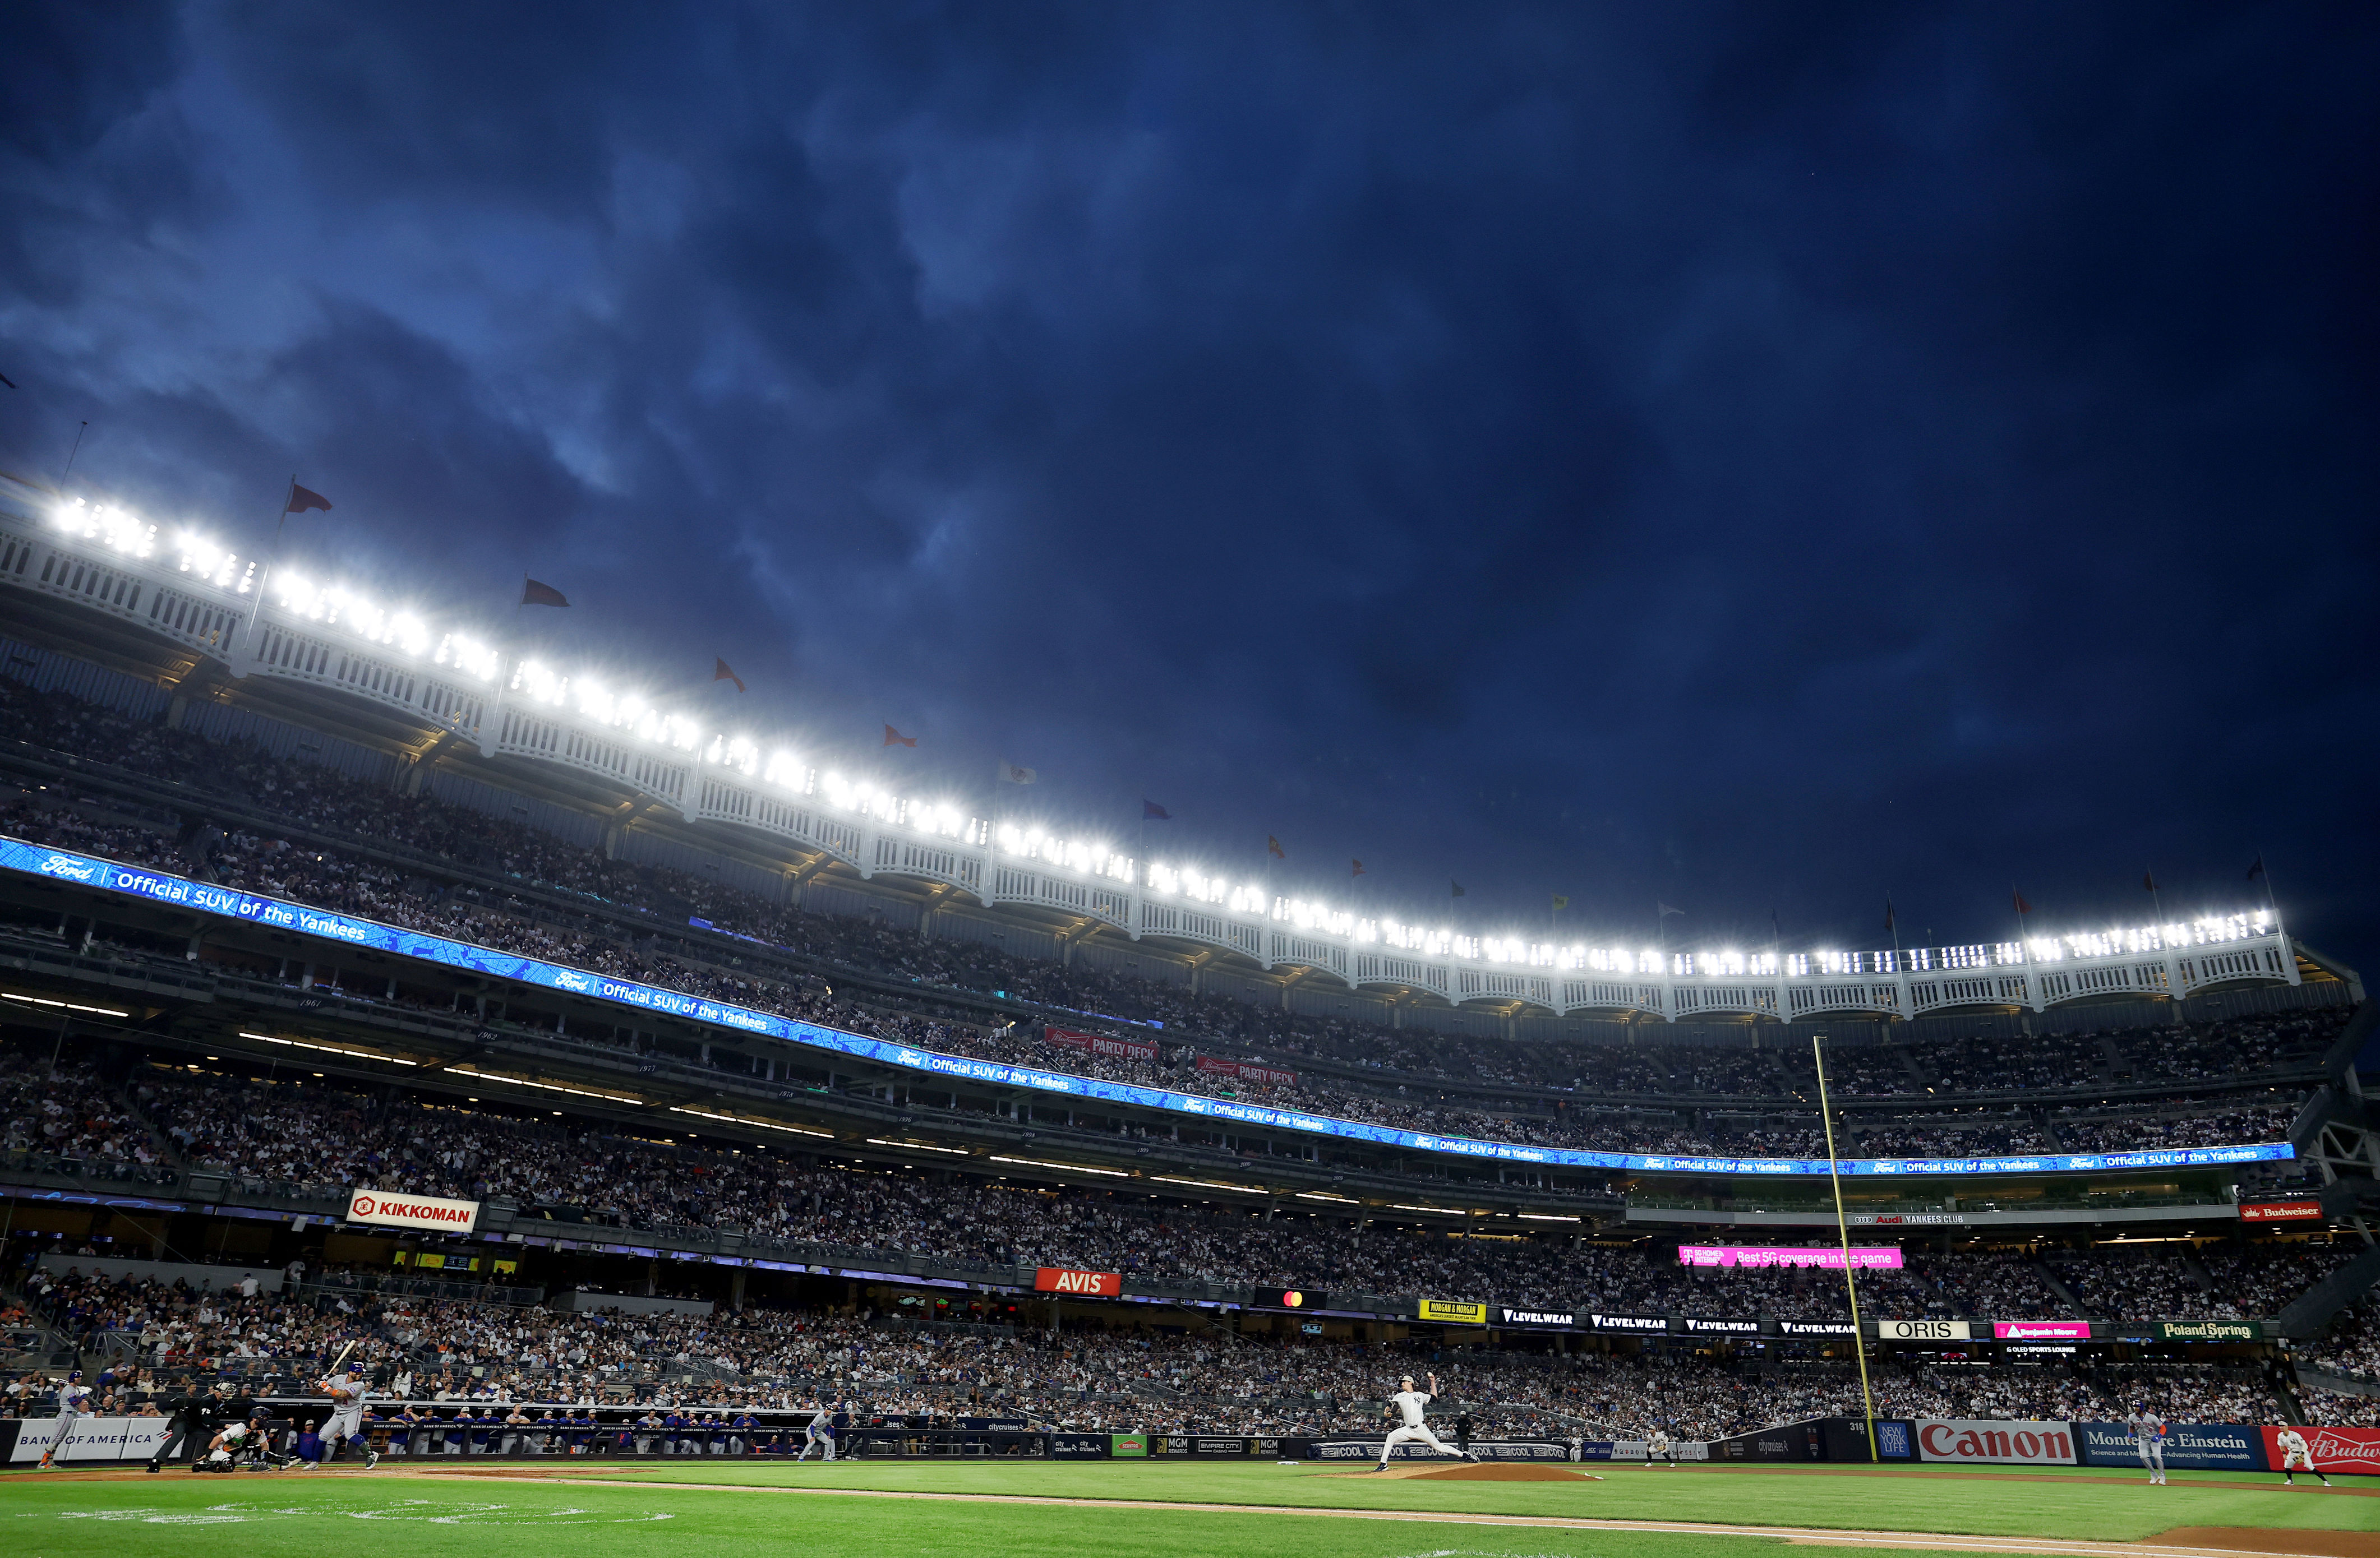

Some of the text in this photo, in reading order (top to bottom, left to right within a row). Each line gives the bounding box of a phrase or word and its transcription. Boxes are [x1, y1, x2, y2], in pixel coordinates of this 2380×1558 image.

[41, 856, 366, 940] Ford Official SUV of the Yankees
[555, 971, 767, 1030] Ford Official SUV of the Yankees
[477, 1031, 498, 1040] 1962
[1054, 1033, 1155, 1060] Budweiser PARTY DECK
[898, 1050, 1069, 1090] Ford Official SUV of the Yankees
[1239, 1065, 1269, 1081] PARTY
[1270, 1071, 1294, 1086] DECK
[1184, 1098, 1323, 1130] Ford Official SUV of the Yankees
[1415, 1136, 1543, 1160] Ford Official SUV of the Yankees
[2069, 1149, 2257, 1168] Ford Official SUV of the Yankees
[1644, 1158, 1791, 1172] Ford Official SUV of the Yankees
[1873, 1160, 2040, 1173] Ford Official SUV of the Yankees
[379, 1202, 470, 1223] KIKKOMAN
[2262, 1207, 2319, 1217] Budweiser
[1906, 1215, 1941, 1223] YANKEES
[1737, 1251, 1760, 1263] Best
[1762, 1251, 1777, 1263] 5G
[1779, 1254, 1826, 1265] coverage
[1828, 1252, 1835, 1263] in
[1861, 1254, 1892, 1265] game
[1055, 1272, 1103, 1293] AVIS
[1431, 1302, 1451, 1312] MORGAN
[1456, 1304, 1476, 1314] MORGAN
[1512, 1311, 1572, 1324] LEVELWEAR
[1602, 1317, 1666, 1329] LEVELWEAR
[1697, 1321, 1758, 1331] LEVELWEAR
[1792, 1324, 1857, 1333] LEVELWEAR
[1896, 1322, 1952, 1338] ORIS
[2163, 1323, 2251, 1339] Poland Spring
[2020, 1328, 2054, 1337] Benjamin
[988, 1423, 1019, 1431] citycruises
[1849, 1422, 1865, 1431] 318
[1881, 1426, 1902, 1435] NEW
[66, 1436, 84, 1444] OF
[87, 1435, 151, 1444] AMERICA
[1168, 1437, 1188, 1448] MGM
[1260, 1439, 1278, 1448] MGM
[1880, 1434, 1906, 1445] YORK
[1921, 1424, 2072, 1458] Canon
[2087, 1431, 2248, 1449] Montere Einstein
[1340, 1446, 1364, 1457] COOL
[1473, 1446, 1493, 1457] COOL
[1511, 1446, 1530, 1457] COOL
[1547, 1446, 1565, 1458] COOL
[1758, 1439, 1784, 1455] citycruises
[1885, 1443, 1904, 1452] LIFE
